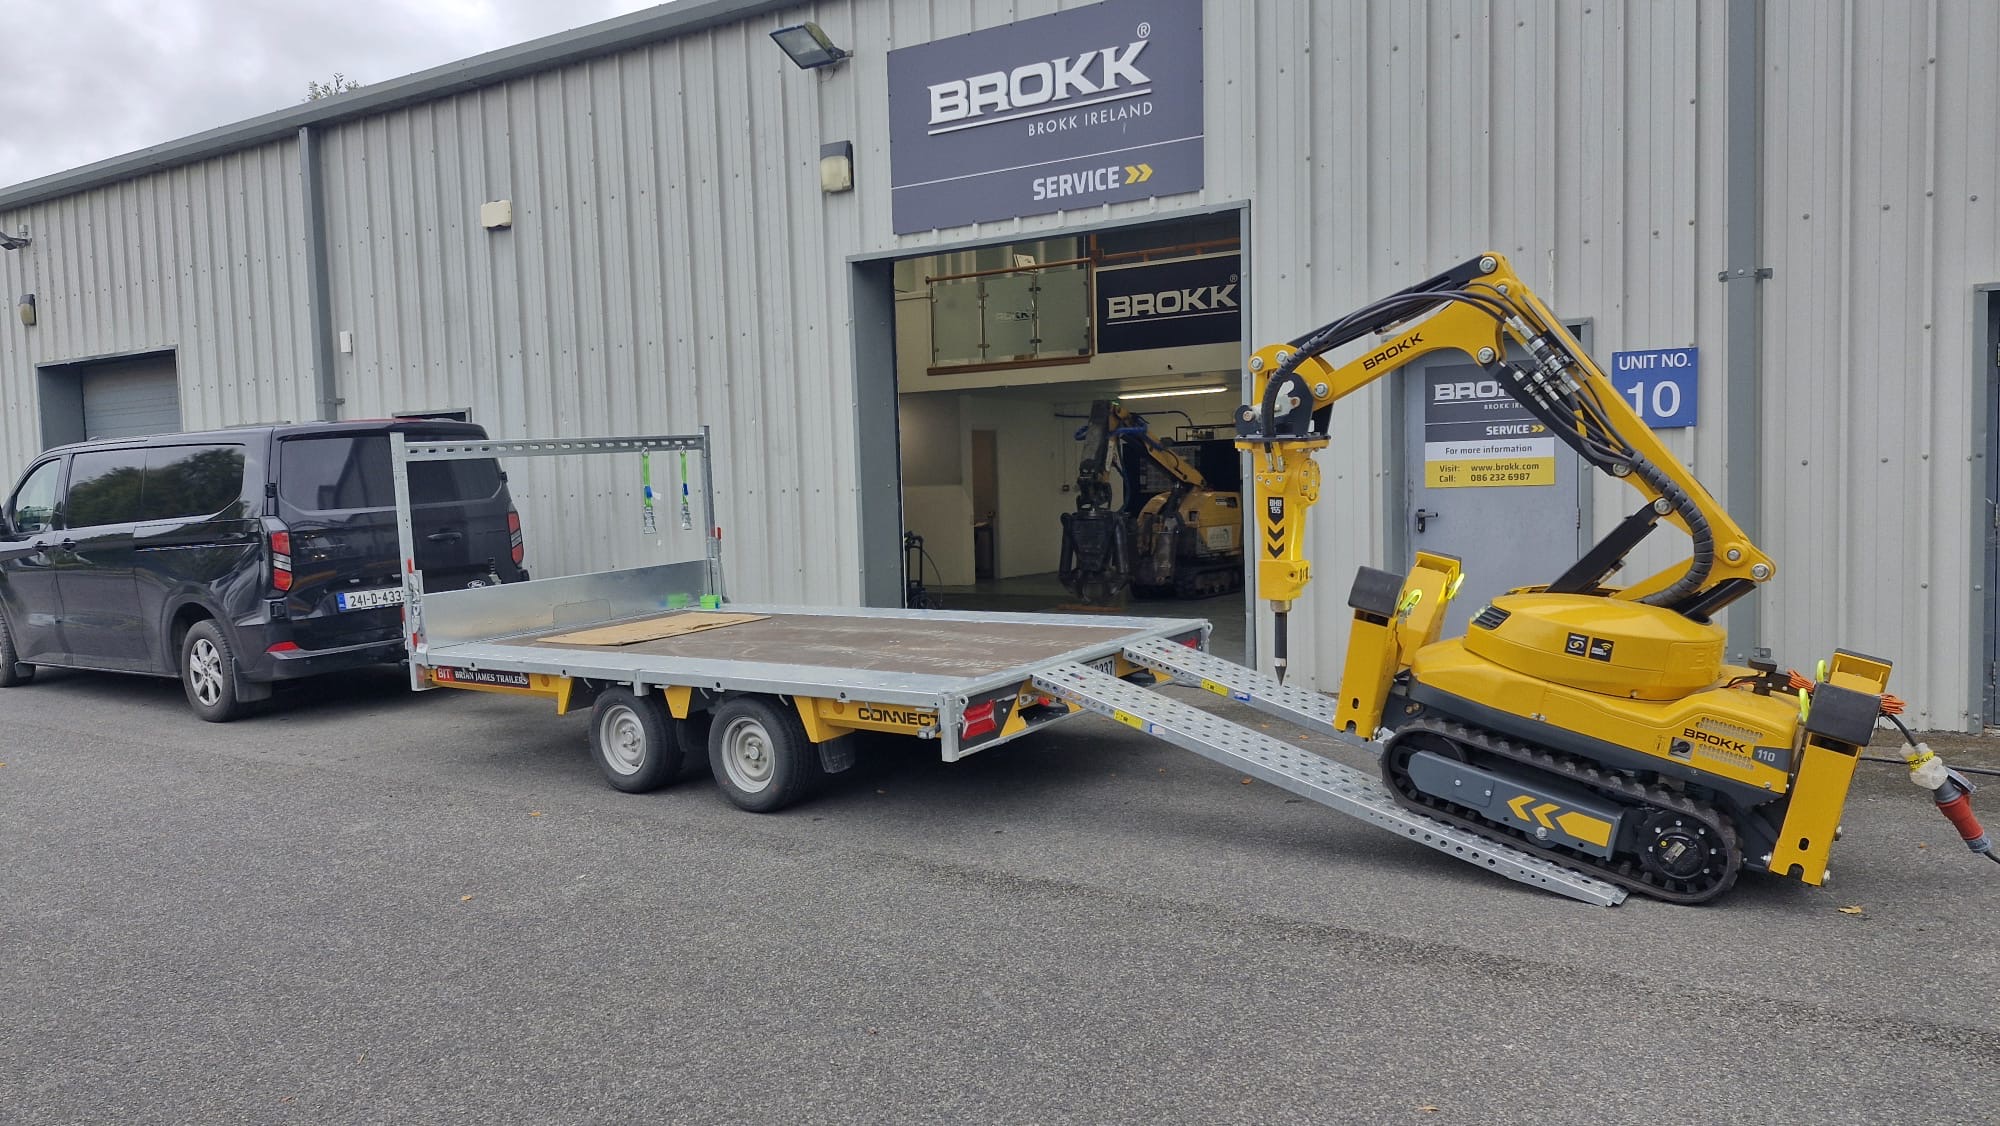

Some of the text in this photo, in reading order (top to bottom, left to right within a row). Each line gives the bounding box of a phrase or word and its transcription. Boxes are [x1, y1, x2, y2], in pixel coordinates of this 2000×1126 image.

[927, 40, 1151, 125] BROKK
[1028, 102, 1153, 136] BROKK IRELAND
[1032, 166, 1120, 201] SERVICE
[1106, 284, 1238, 319] BROKK
[1362, 332, 1424, 370] BROKK
[1619, 352, 1692, 371] UNIT NO.
[1433, 381, 1506, 400] BRO
[1627, 380, 1681, 418] 10
[1486, 424, 1530, 435] SERVICE
[1445, 447, 1458, 455] For
[1483, 445, 1532, 453] information
[1470, 463, 1540, 471] www.brokk.com
[1490, 473, 1506, 481] 232
[1507, 473, 1530, 481] 6987
[349, 590, 404, 607] 241-D-433
[454, 670, 474, 679] BRIAN
[475, 672, 495, 682] JAMES
[858, 707, 939, 727] CONNECT
[1683, 728, 1776, 762] BROKK 110
